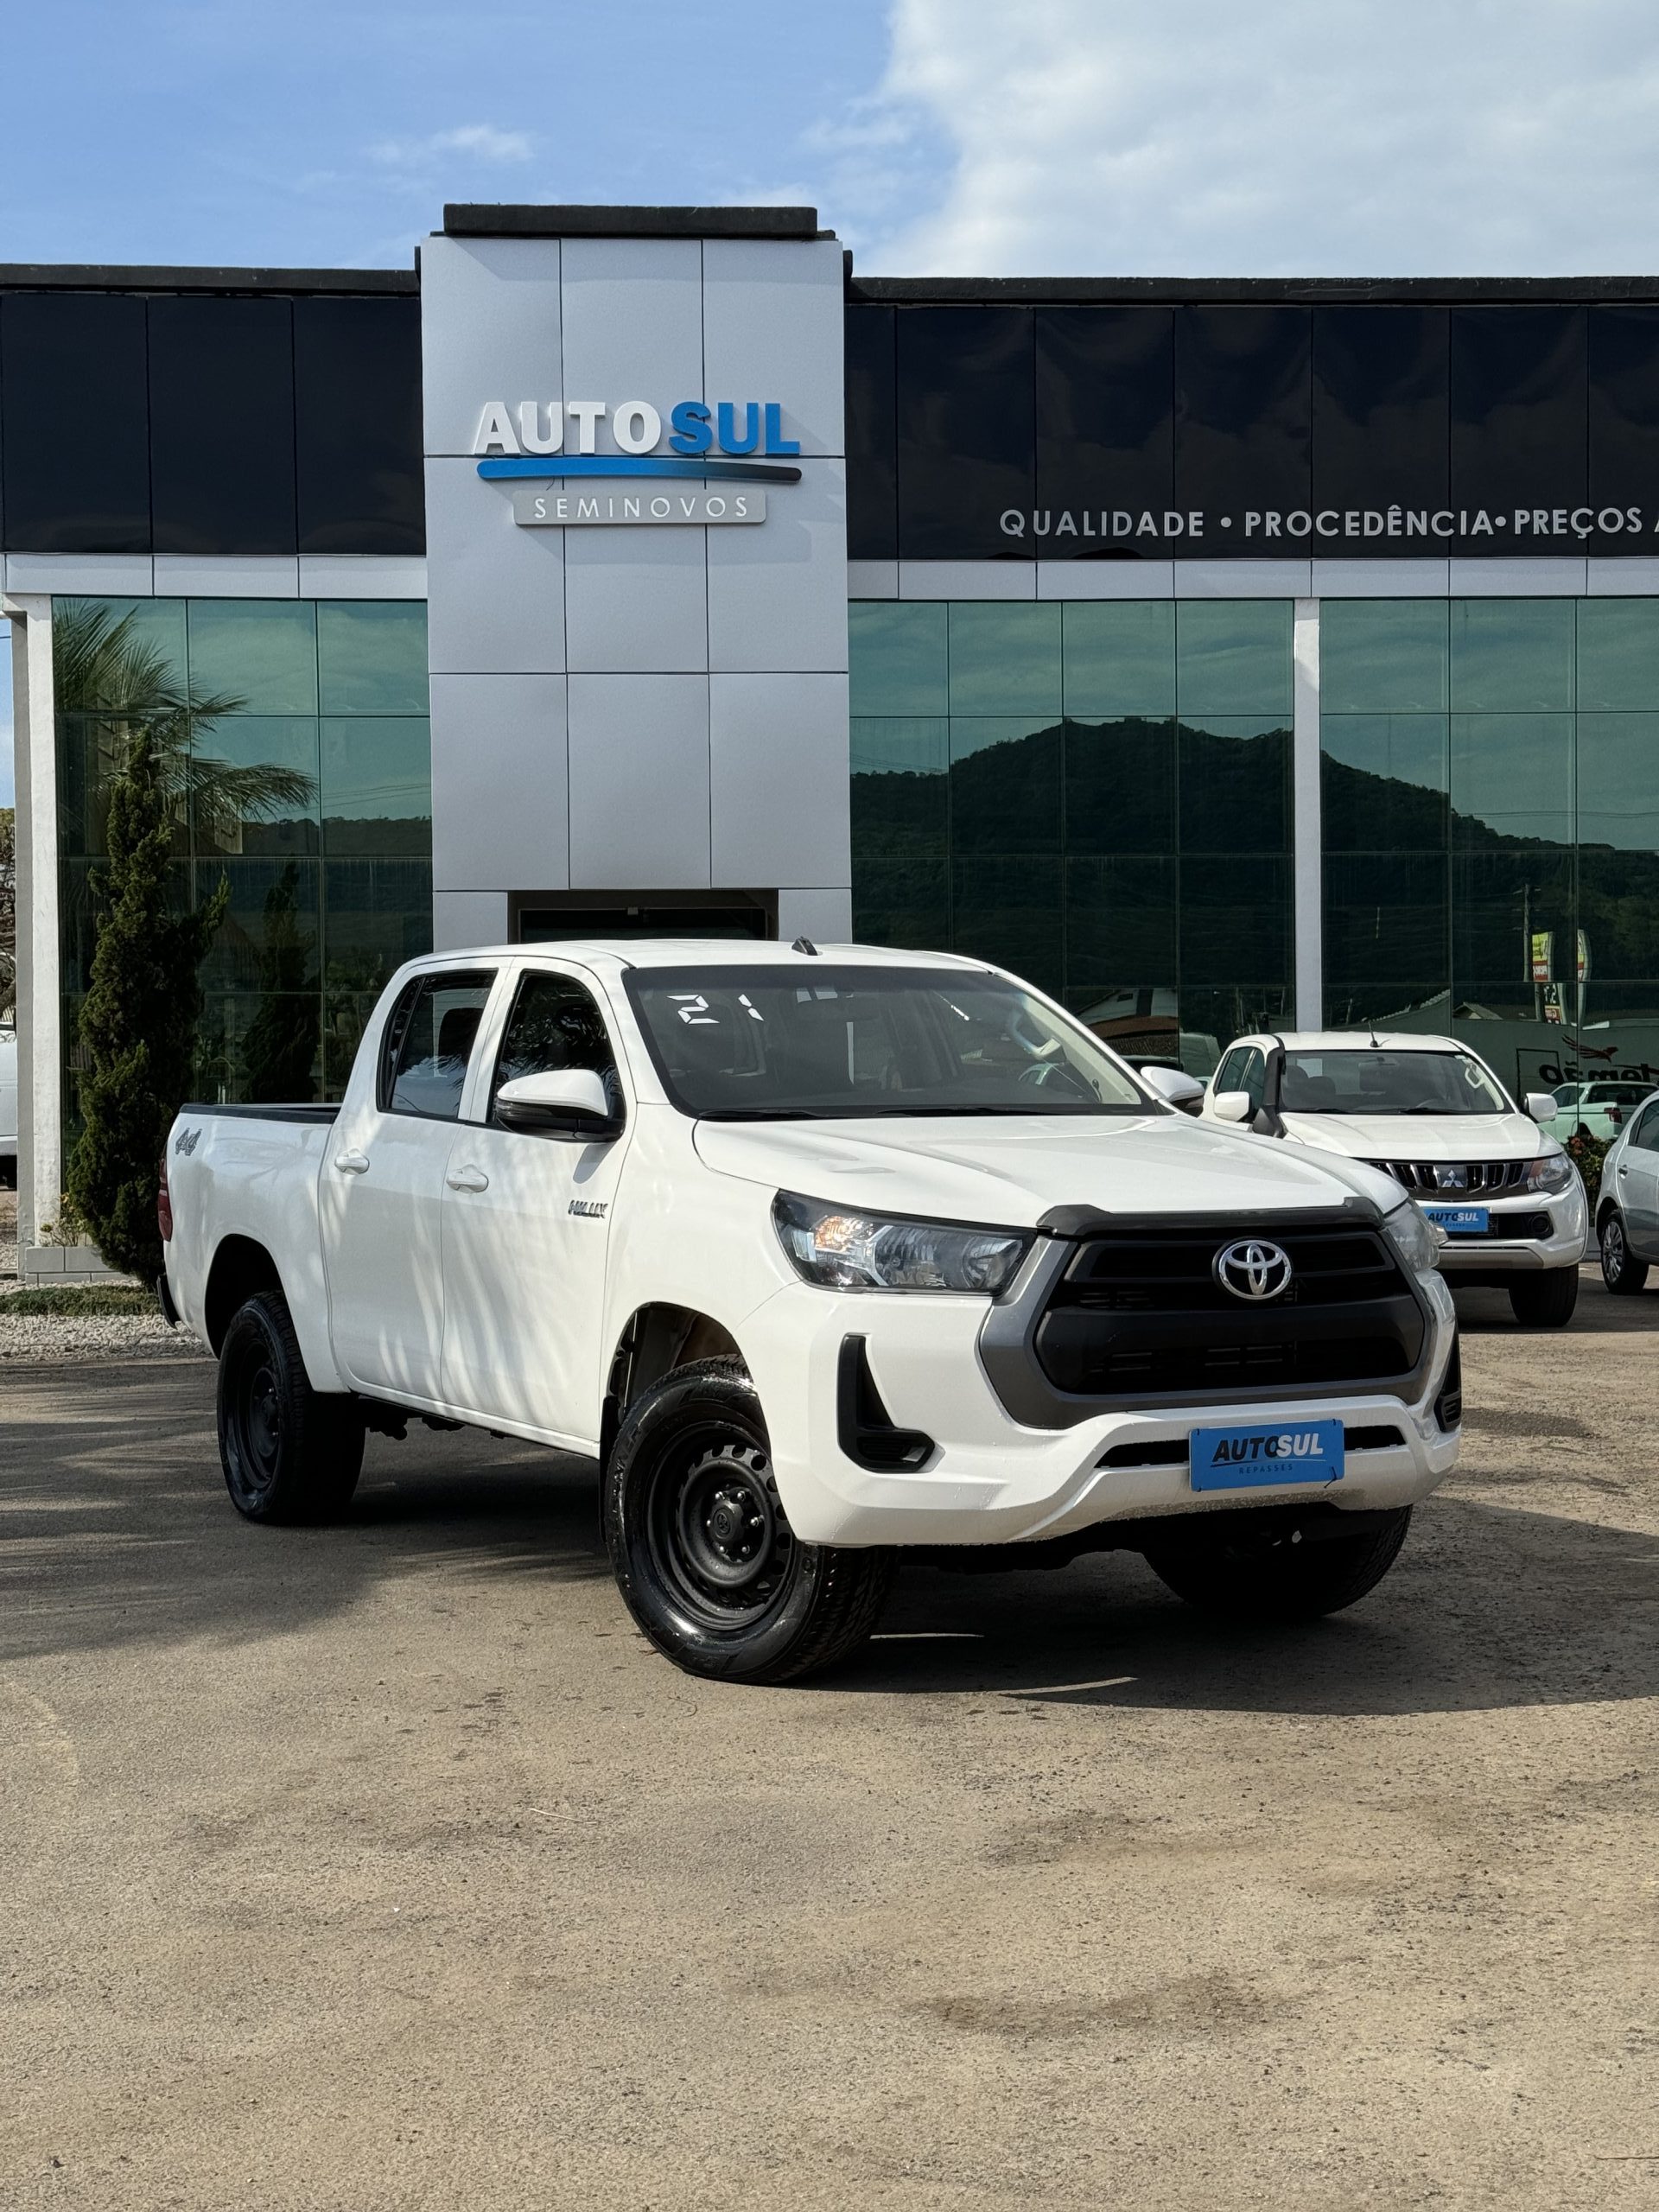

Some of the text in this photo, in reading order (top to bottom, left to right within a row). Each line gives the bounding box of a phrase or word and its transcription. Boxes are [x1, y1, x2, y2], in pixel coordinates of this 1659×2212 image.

[533, 495, 749, 518] SEMINOVOS
[999, 509, 1205, 538] QUALIDADE
[1244, 504, 1495, 537] PROCEDÊNCIA
[1514, 506, 1643, 539] PREÇOS
[666, 994, 765, 1025] 21
[568, 1199, 608, 1219] HILUX
[1427, 1211, 1479, 1223] AUTOSUL
[1211, 1433, 1324, 1463] AUTOSUL
[1238, 1463, 1294, 1475] REPASSES
